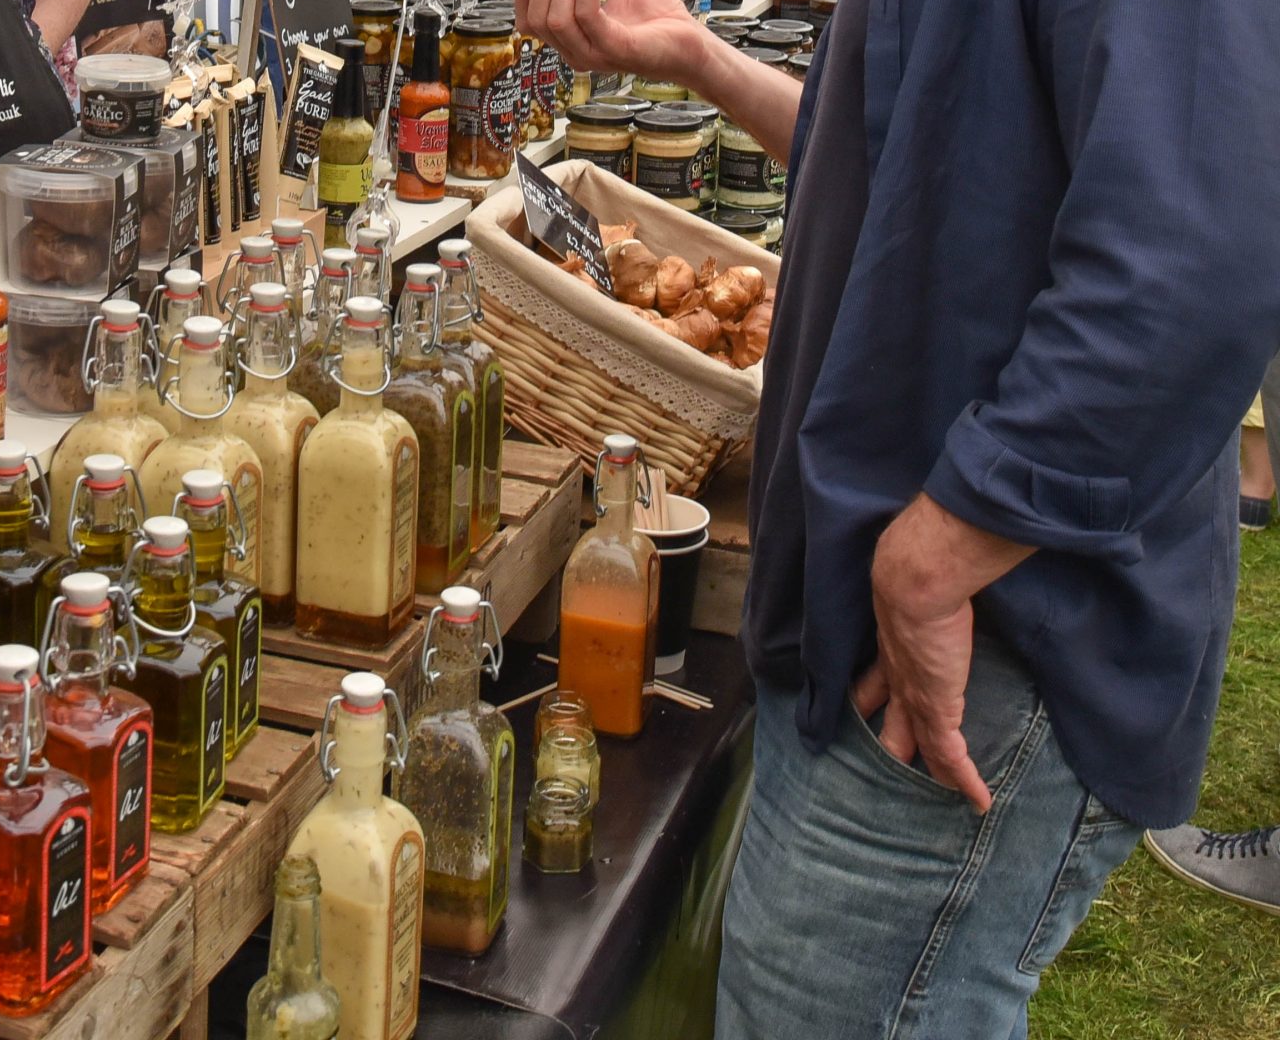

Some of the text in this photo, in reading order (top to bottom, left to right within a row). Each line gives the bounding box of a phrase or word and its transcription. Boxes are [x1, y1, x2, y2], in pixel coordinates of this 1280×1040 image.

[282, 24, 350, 50] Choose your own
[298, 80, 333, 104] Garli
[84, 106, 123, 120] GARLIC
[522, 174, 547, 201] Large
[524, 187, 551, 216] Garlic
[175, 197, 196, 226] GARLIC
[114, 224, 138, 254] GARLIC
[566, 232, 594, 262] £2.50
